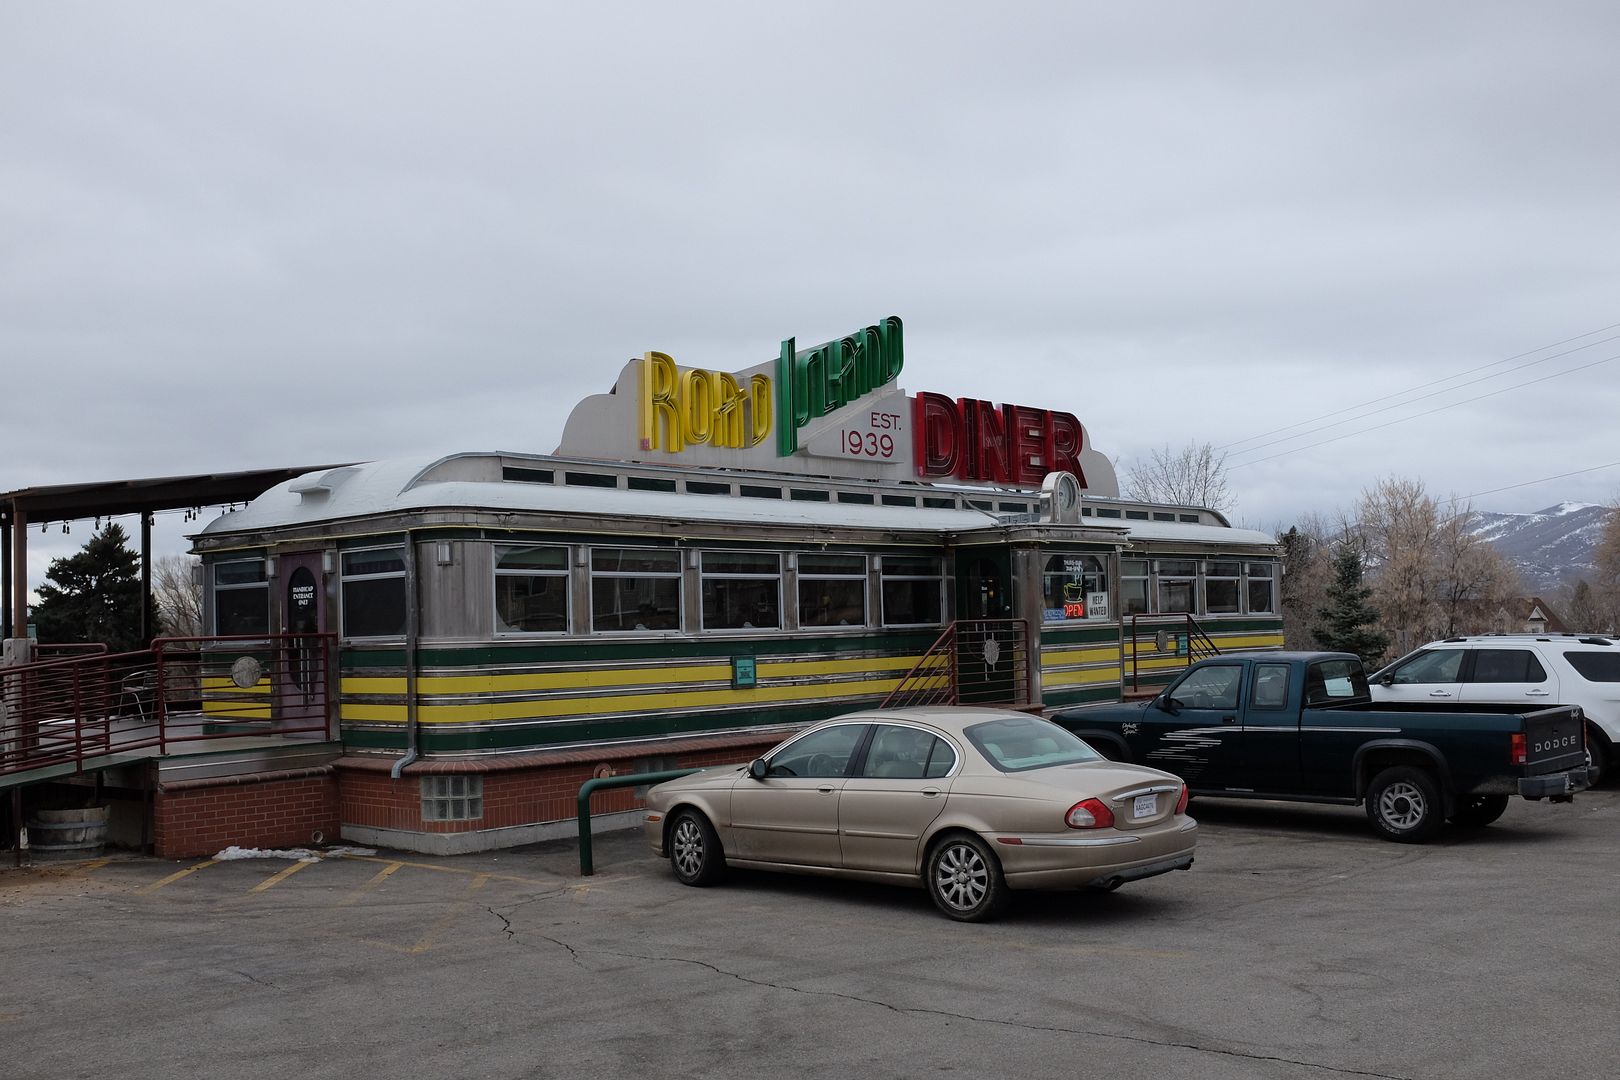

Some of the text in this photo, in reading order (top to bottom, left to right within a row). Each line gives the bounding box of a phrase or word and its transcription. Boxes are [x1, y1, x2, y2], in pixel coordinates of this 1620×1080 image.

[780, 315, 904, 457] ISLAND
[643, 351, 772, 453] ROAD
[871, 411, 902, 431] EST.
[840, 429, 895, 458] 1939
[915, 391, 1089, 490] DINER
[1092, 595, 1104, 605] HELP
[1063, 604, 1084, 617] OPEN
[1089, 606, 1107, 616] WANTED
[1534, 735, 1577, 753] DODGE
